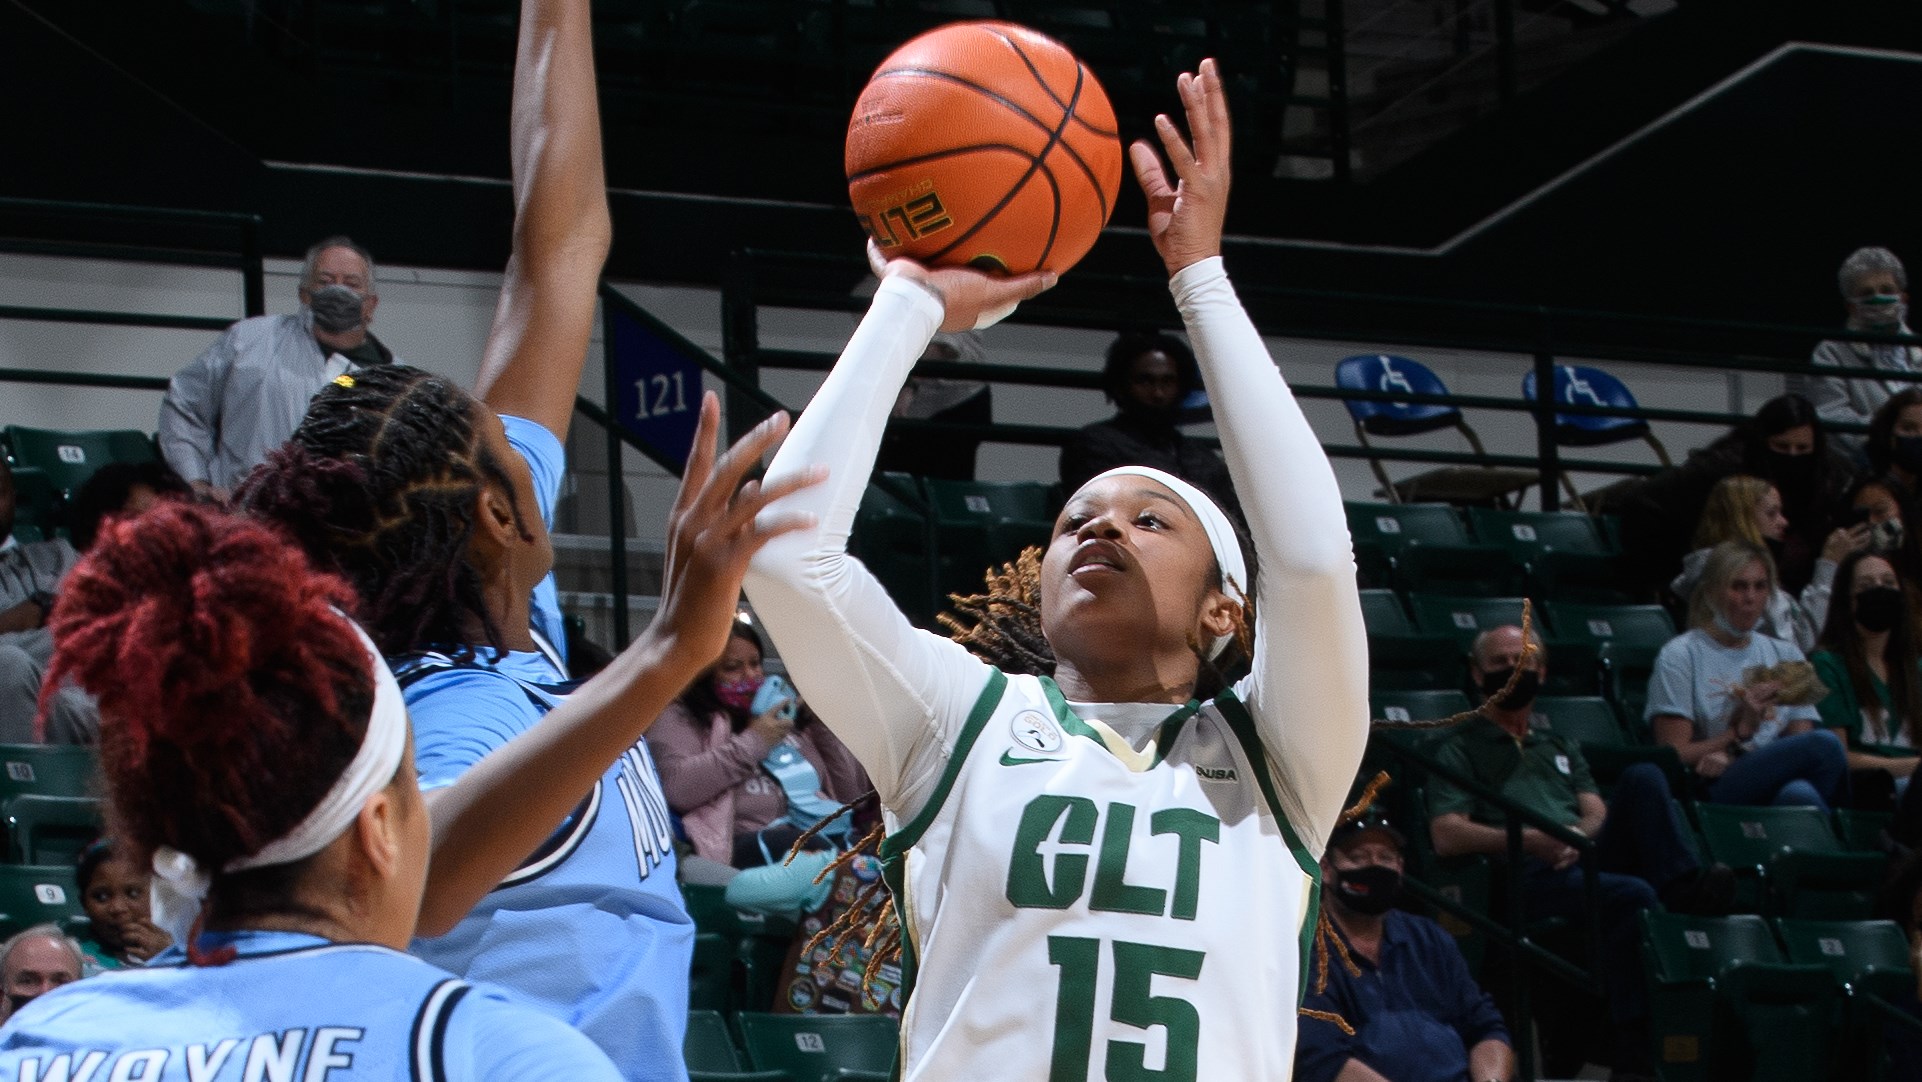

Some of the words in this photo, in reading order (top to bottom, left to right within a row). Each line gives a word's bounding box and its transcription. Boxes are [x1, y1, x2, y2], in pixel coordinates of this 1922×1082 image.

[634, 370, 687, 419] 121
[1006, 794, 1221, 921] CLT
[1047, 935, 1206, 1082] 15
